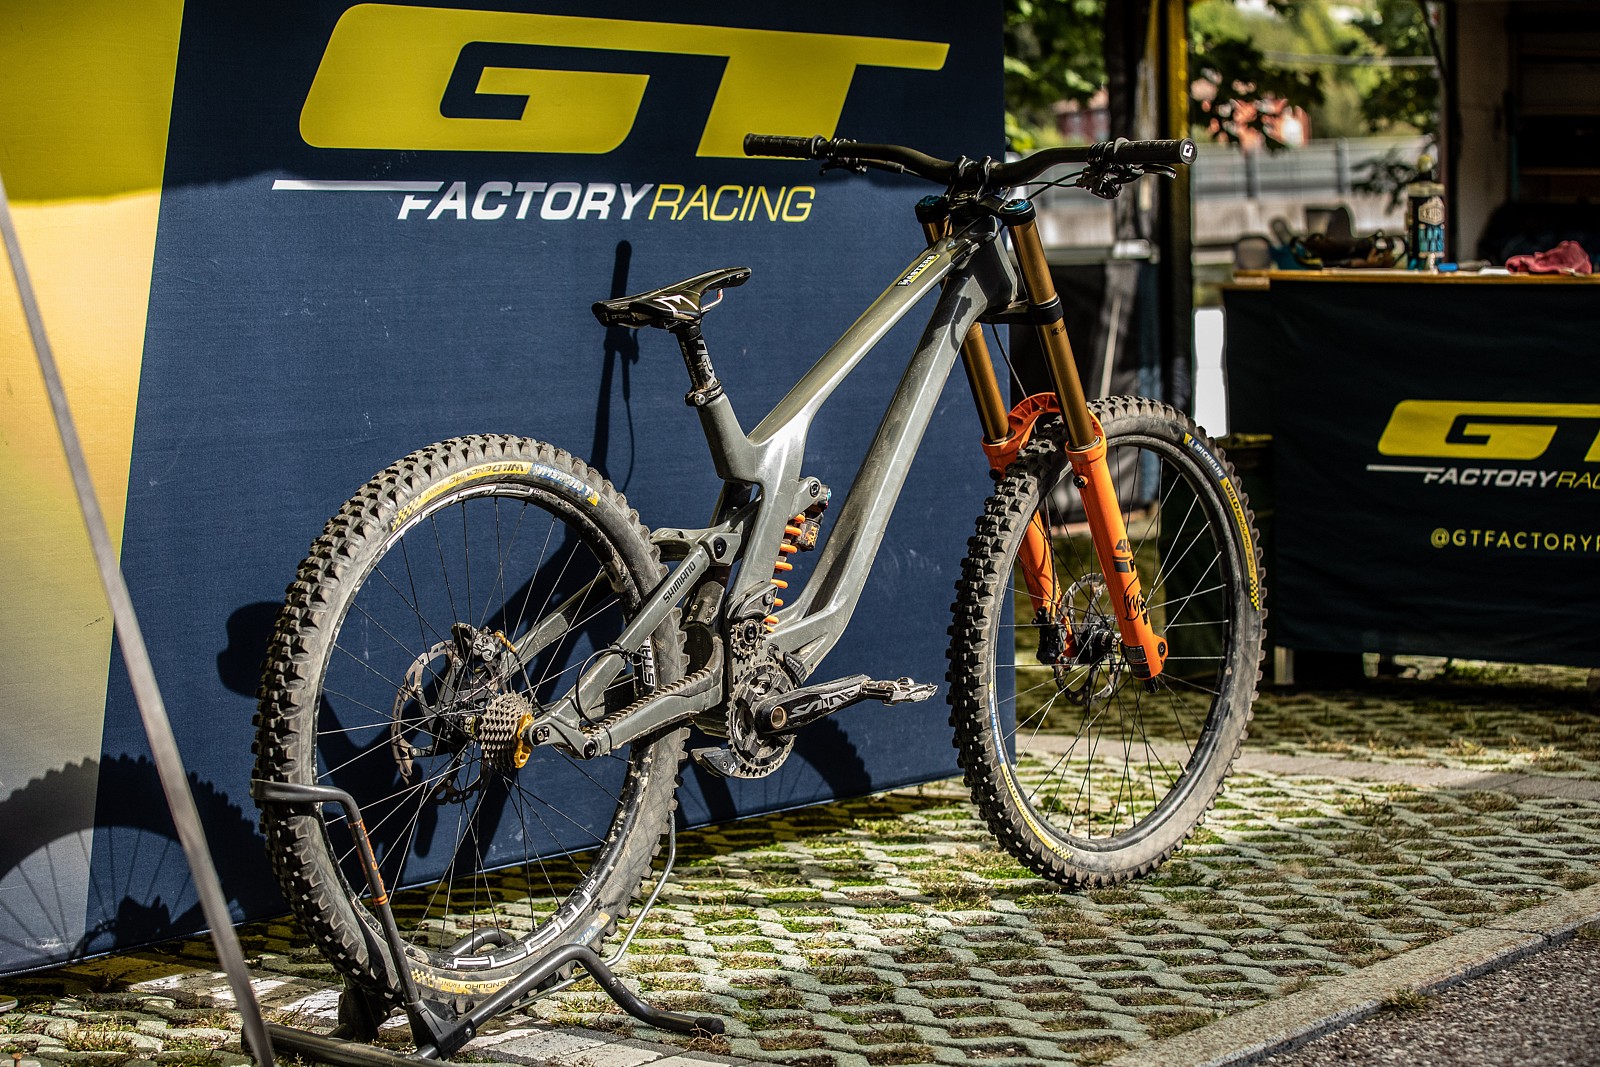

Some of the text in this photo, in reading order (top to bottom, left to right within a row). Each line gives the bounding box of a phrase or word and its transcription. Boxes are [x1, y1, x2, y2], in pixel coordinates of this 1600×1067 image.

[300, 3, 950, 158] GT
[1194, 442, 1224, 478] MICHELIN
[662, 561, 697, 604] SHIMANO
